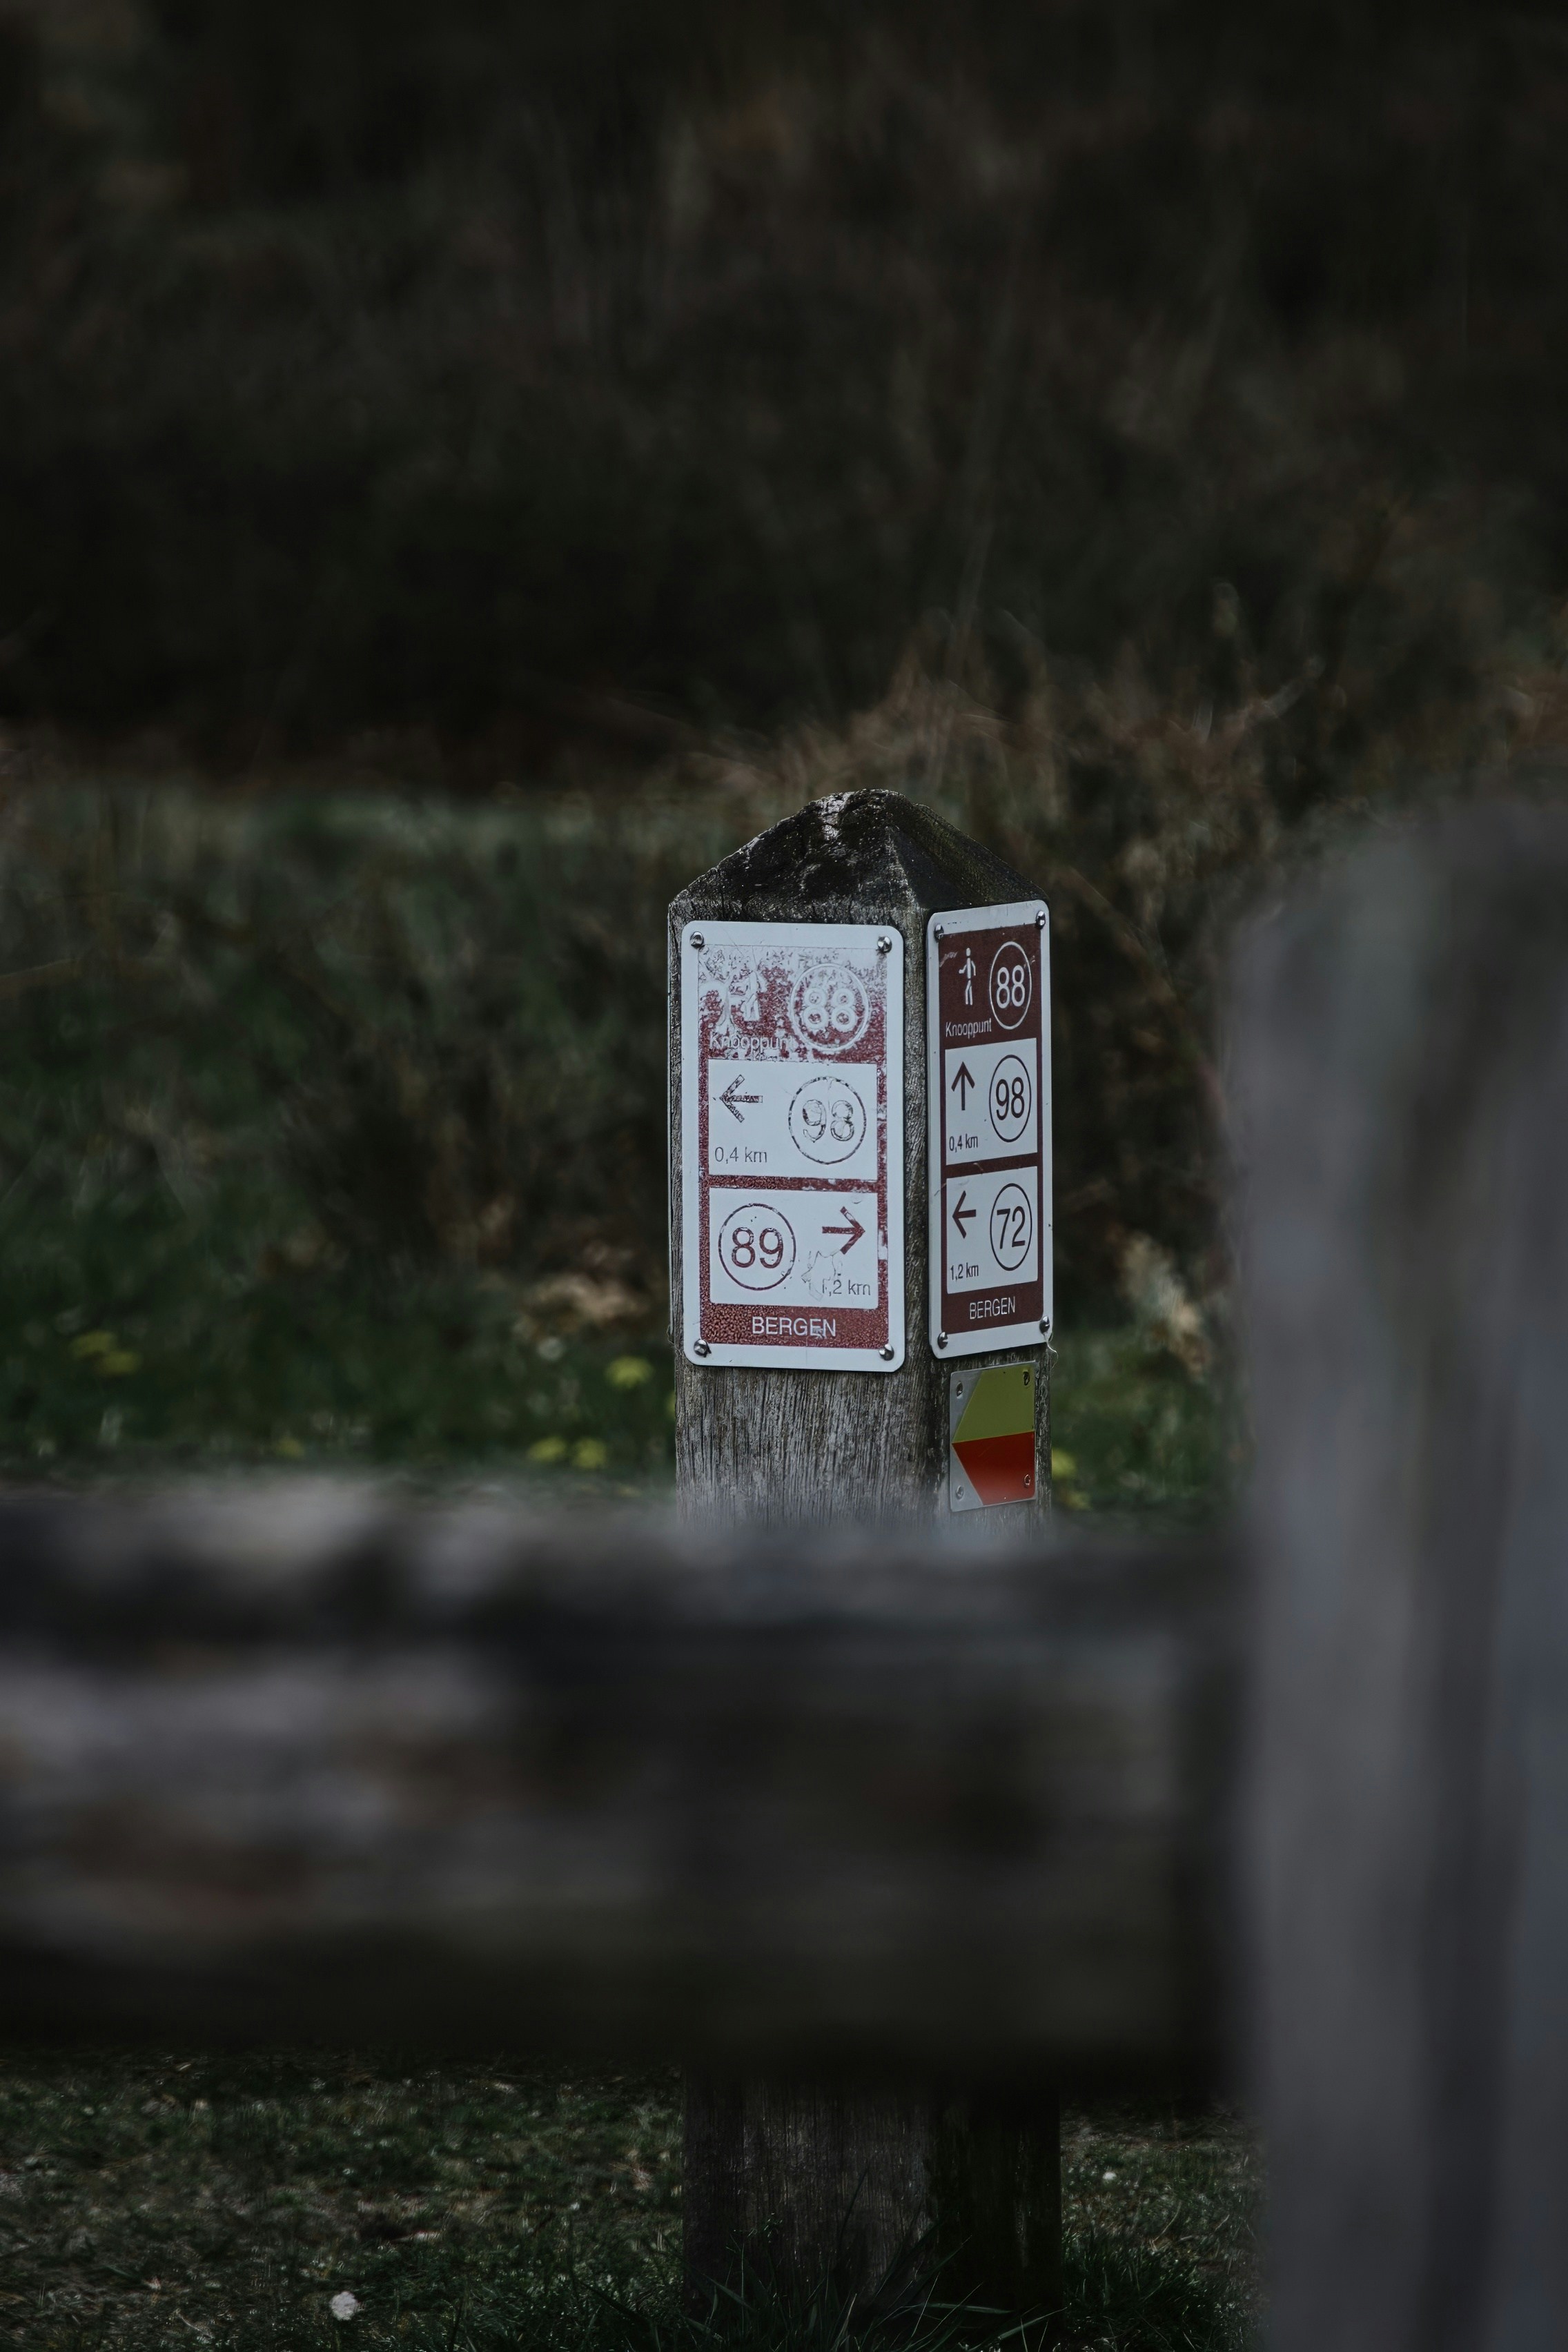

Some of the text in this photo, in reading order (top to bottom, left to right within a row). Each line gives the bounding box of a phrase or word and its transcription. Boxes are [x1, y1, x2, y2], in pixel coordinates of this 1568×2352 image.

[996, 964, 1026, 1009] 88
[945, 1017, 992, 1039] Knooppunt
[995, 1077, 1025, 1121] 98
[802, 1099, 854, 1142] 98
[948, 1134, 979, 1153] 0,4 km
[714, 1146, 767, 1165] 0,4 km
[996, 1206, 1026, 1250] 72
[731, 1226, 784, 1269] 89
[950, 1262, 979, 1281] 1,2 km
[847, 1280, 871, 1296] km
[969, 1295, 1016, 1320] BERGEN
[752, 1316, 836, 1337] BERGEN
